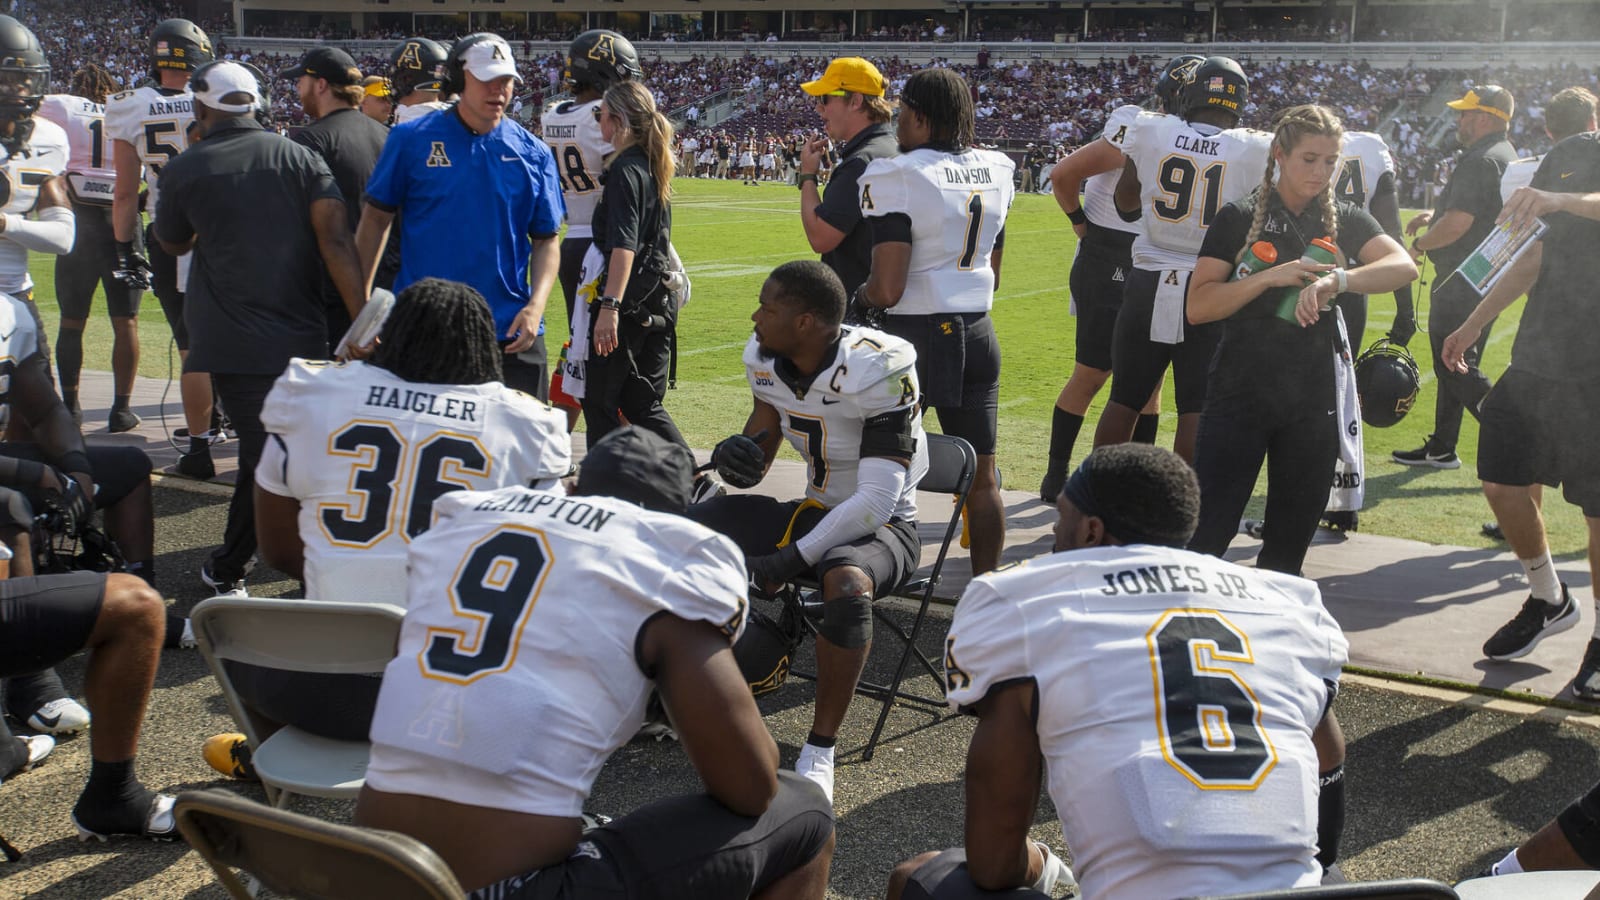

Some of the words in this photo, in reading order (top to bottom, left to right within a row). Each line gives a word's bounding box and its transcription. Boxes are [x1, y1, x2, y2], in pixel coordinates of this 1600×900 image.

[492, 44, 505, 60] A
[1227, 84, 1236, 94] 91
[1222, 100, 1238, 110] STATE
[142, 119, 196, 166] 5
[1111, 125, 1127, 144] A
[1174, 134, 1220, 156] CLARK
[426, 141, 452, 167] A
[945, 167, 992, 185] DAWSON
[1151, 153, 1228, 229] 91
[860, 183, 875, 210] A
[957, 190, 985, 272] 1
[829, 364, 848, 393] C
[365, 386, 476, 422] HAIGLER
[1348, 420, 1358, 437] G
[786, 410, 831, 494] 7
[318, 419, 492, 548] 36
[473, 494, 616, 532] HAMPTON
[1101, 565, 1206, 596] JONES
[418, 524, 555, 686] 9
[1146, 607, 1277, 791] 6
